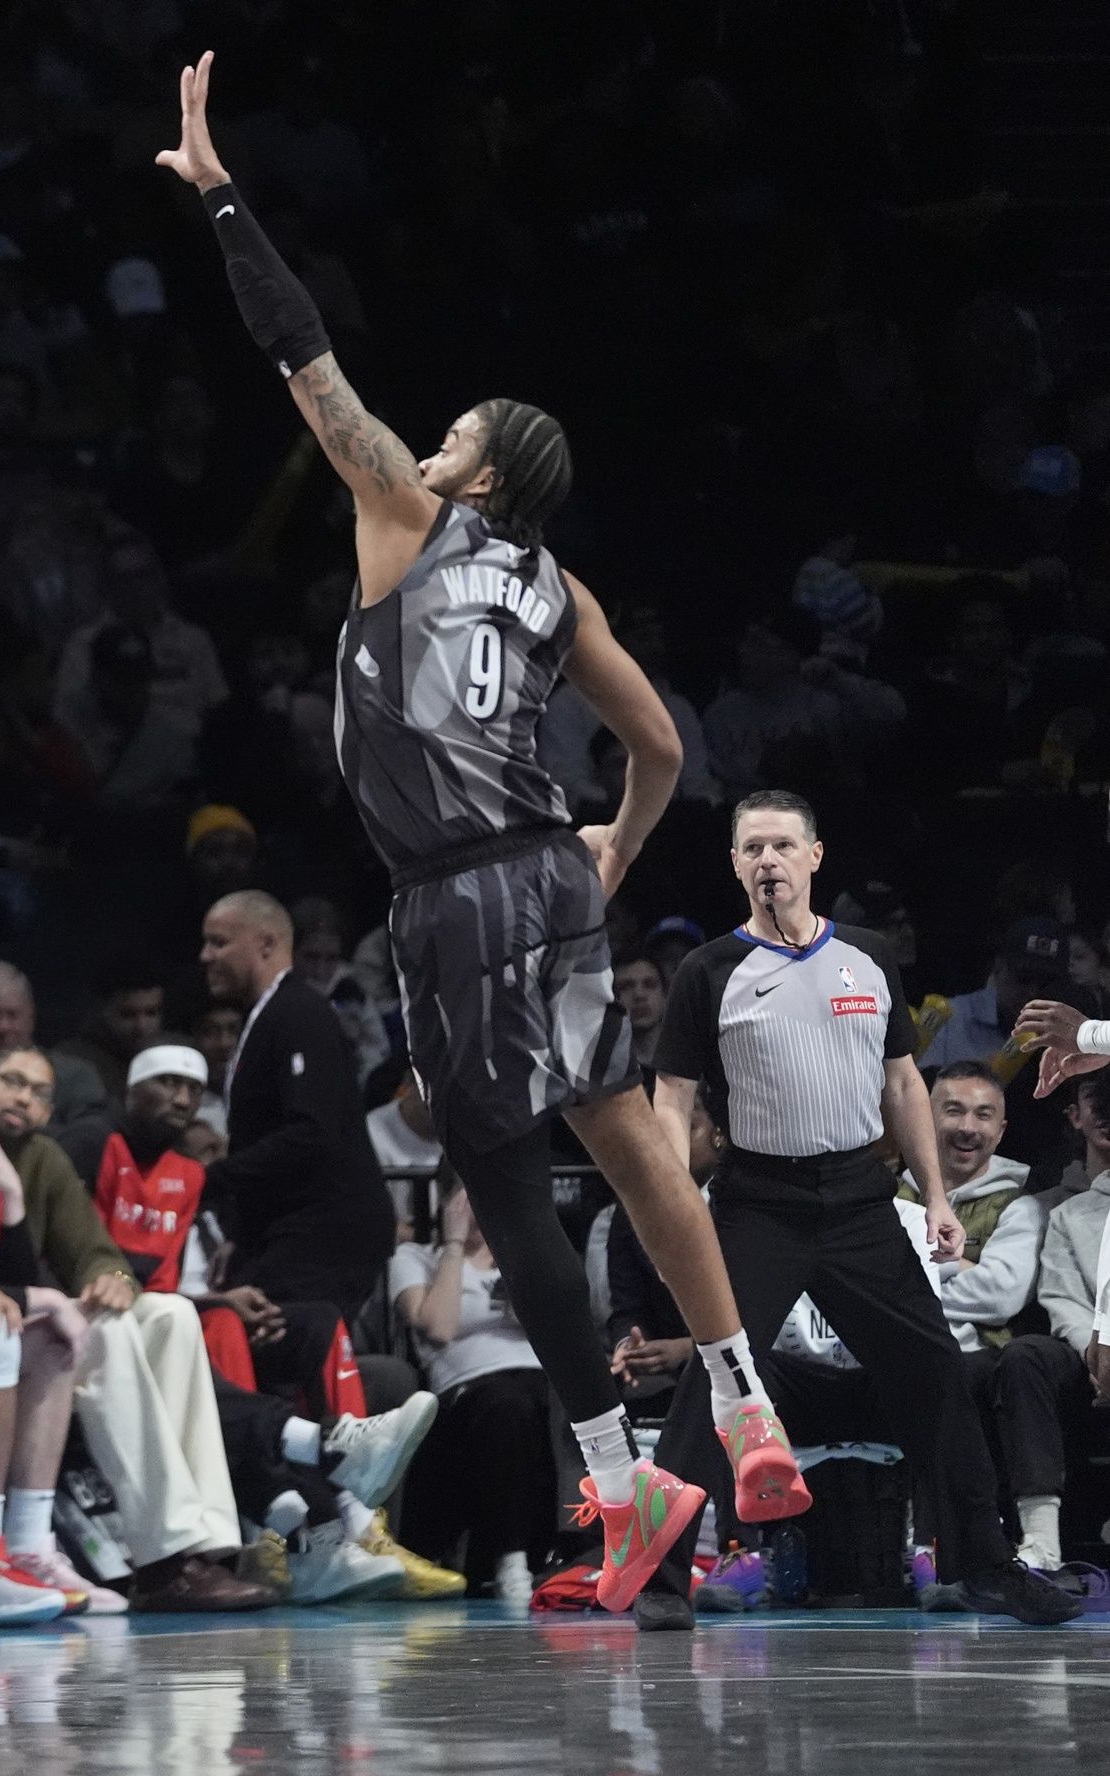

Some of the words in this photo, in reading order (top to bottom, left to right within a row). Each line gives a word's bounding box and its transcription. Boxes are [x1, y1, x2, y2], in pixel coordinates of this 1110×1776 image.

[441, 564, 551, 633] WATFORD
[465, 623, 502, 719] 9
[832, 999, 877, 1012] Emirates
